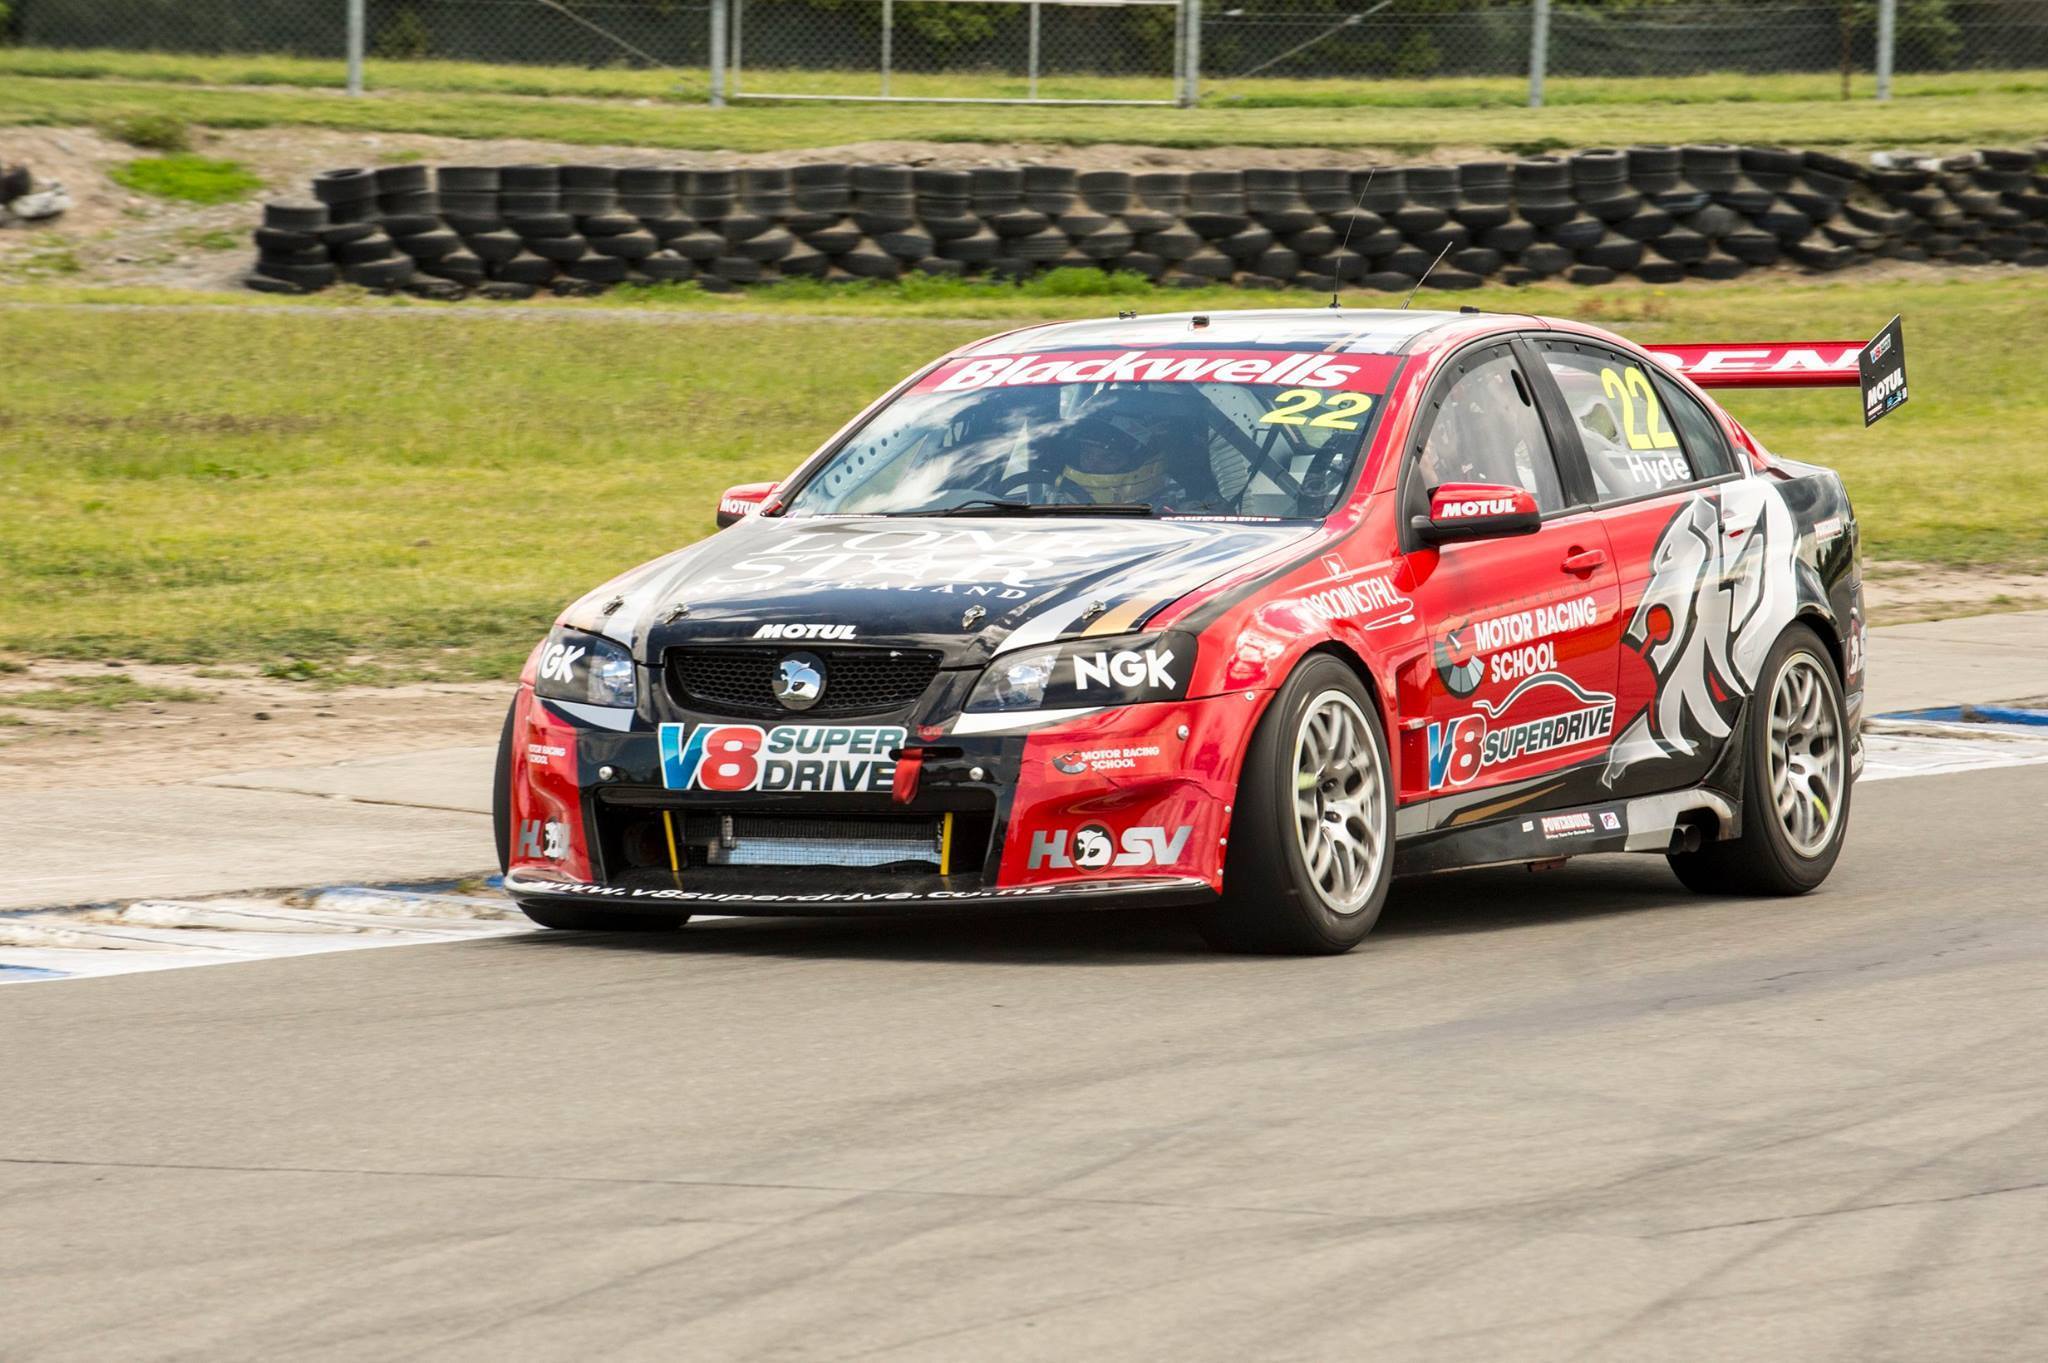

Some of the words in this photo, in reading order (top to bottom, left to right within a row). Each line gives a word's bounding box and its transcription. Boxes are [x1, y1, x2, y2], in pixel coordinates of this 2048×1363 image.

[933, 352, 1361, 392] Blackwells
[1867, 367, 1904, 410] MOTUL
[1259, 389, 1372, 430] 22
[1601, 367, 1679, 450] 22
[1625, 454, 1691, 489] Hyde
[1441, 500, 1516, 517] MOTUL
[753, 624, 856, 640] MOTUL
[1474, 612, 1533, 651] MOTOR
[1537, 596, 1598, 634] RACING
[1073, 649, 1177, 691] NGK
[1490, 641, 1558, 684] SCHOOL
[658, 722, 767, 791] V8
[767, 727, 906, 755] SUPER
[1081, 750, 1121, 762] MOTOR
[1123, 746, 1160, 758] RACING
[1091, 758, 1136, 771] SCHOOL
[1427, 713, 1487, 791] V8
[1483, 703, 1616, 767] SUPERDRIVE
[759, 759, 896, 792] DRIVE
